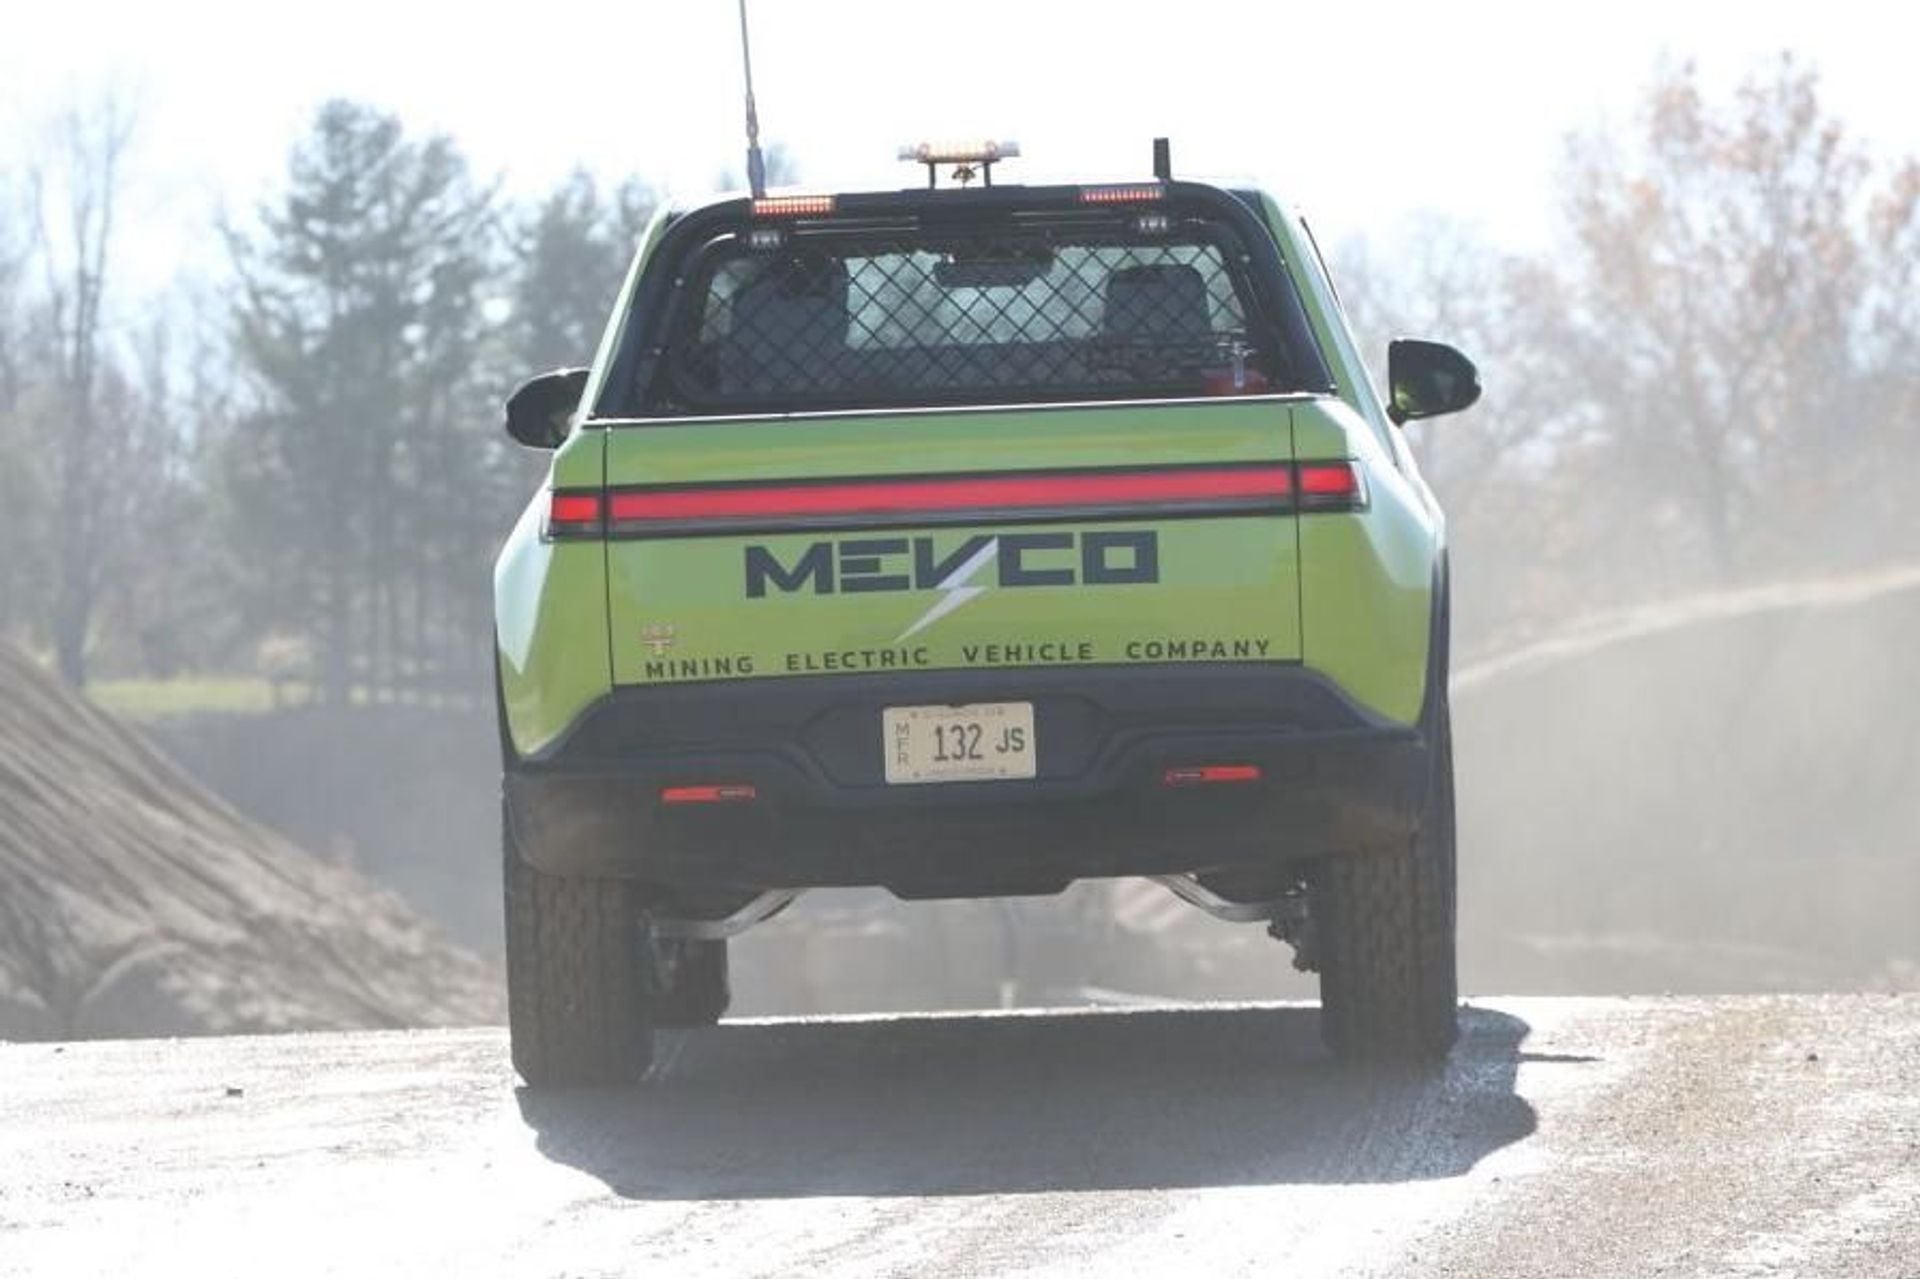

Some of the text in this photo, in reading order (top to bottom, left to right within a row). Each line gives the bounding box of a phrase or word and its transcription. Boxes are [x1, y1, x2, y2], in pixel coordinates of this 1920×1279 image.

[745, 531, 1159, 598] MEVCO
[645, 639, 1270, 678] MINING ELECTRIC VEHICLE COMPANY
[933, 722, 1026, 762] 132 JS
